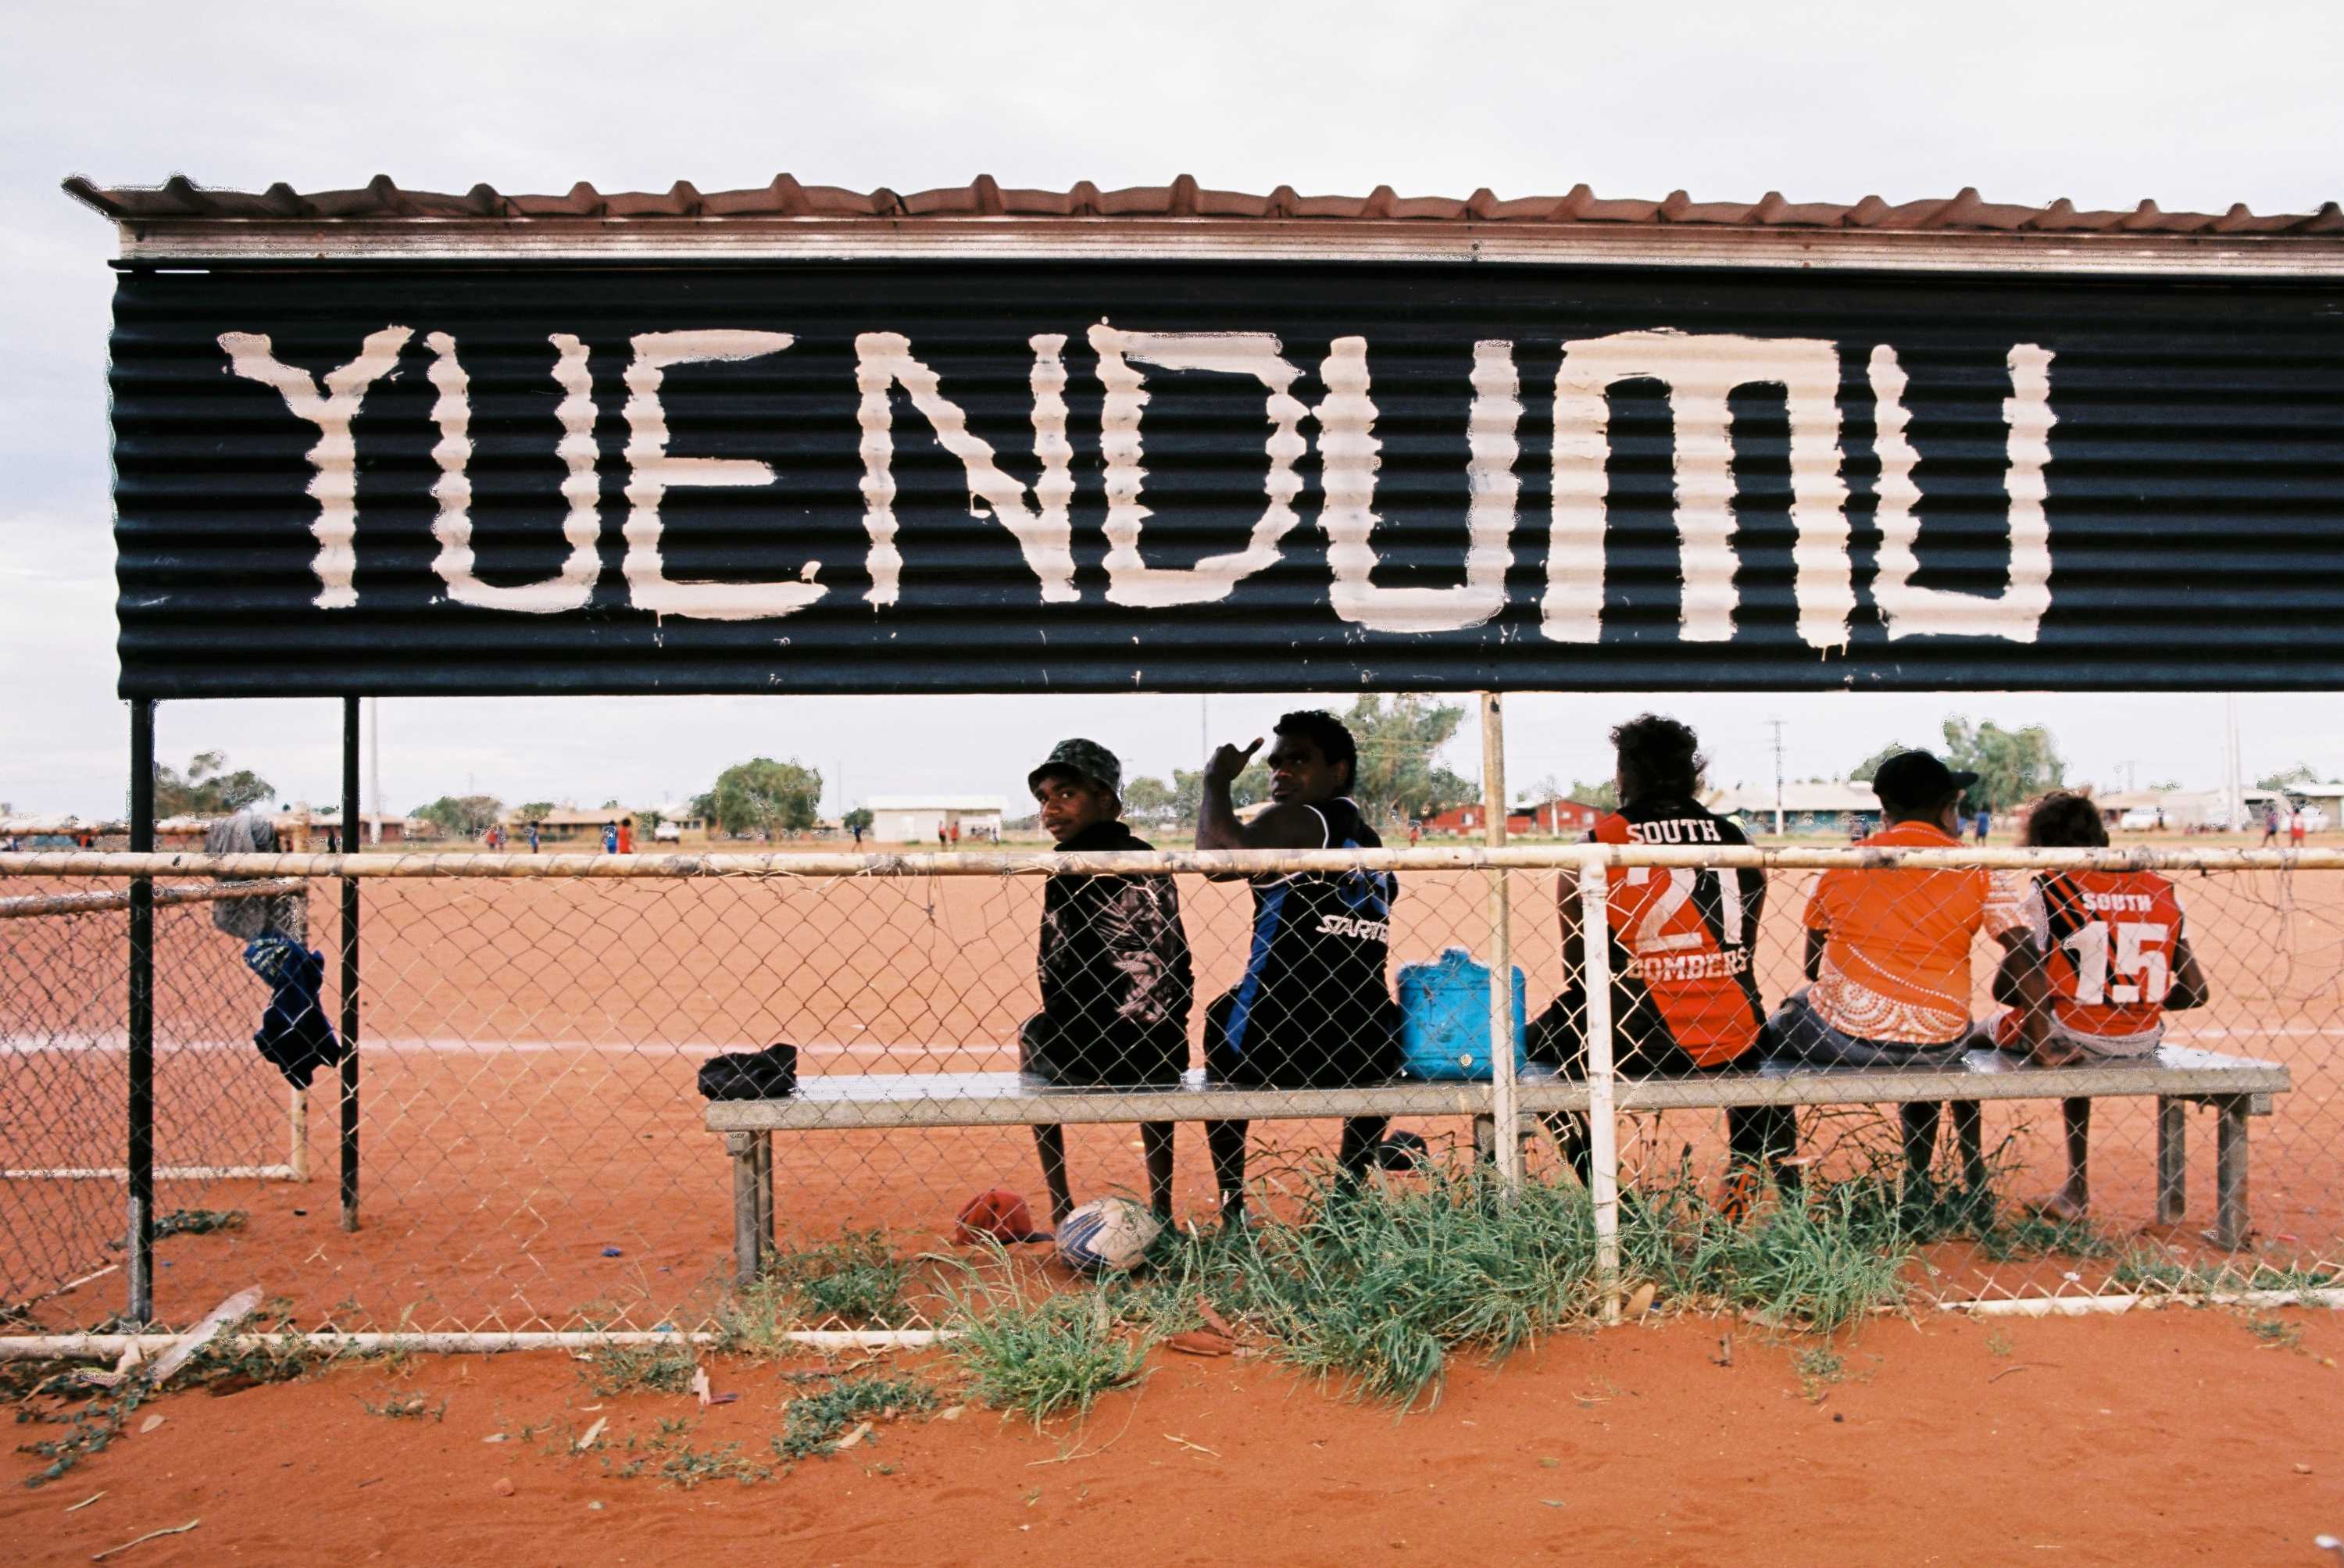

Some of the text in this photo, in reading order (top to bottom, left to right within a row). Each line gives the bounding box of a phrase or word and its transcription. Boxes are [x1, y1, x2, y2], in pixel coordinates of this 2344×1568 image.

[217, 323, 2059, 649] YUENDUMU
[1626, 818, 1721, 845] SOUTH
[1625, 867, 1743, 952] 21
[2081, 892, 2153, 912] SOUTH
[1626, 946, 1750, 981] BOMBERS
[2063, 921, 2169, 1005] 15
